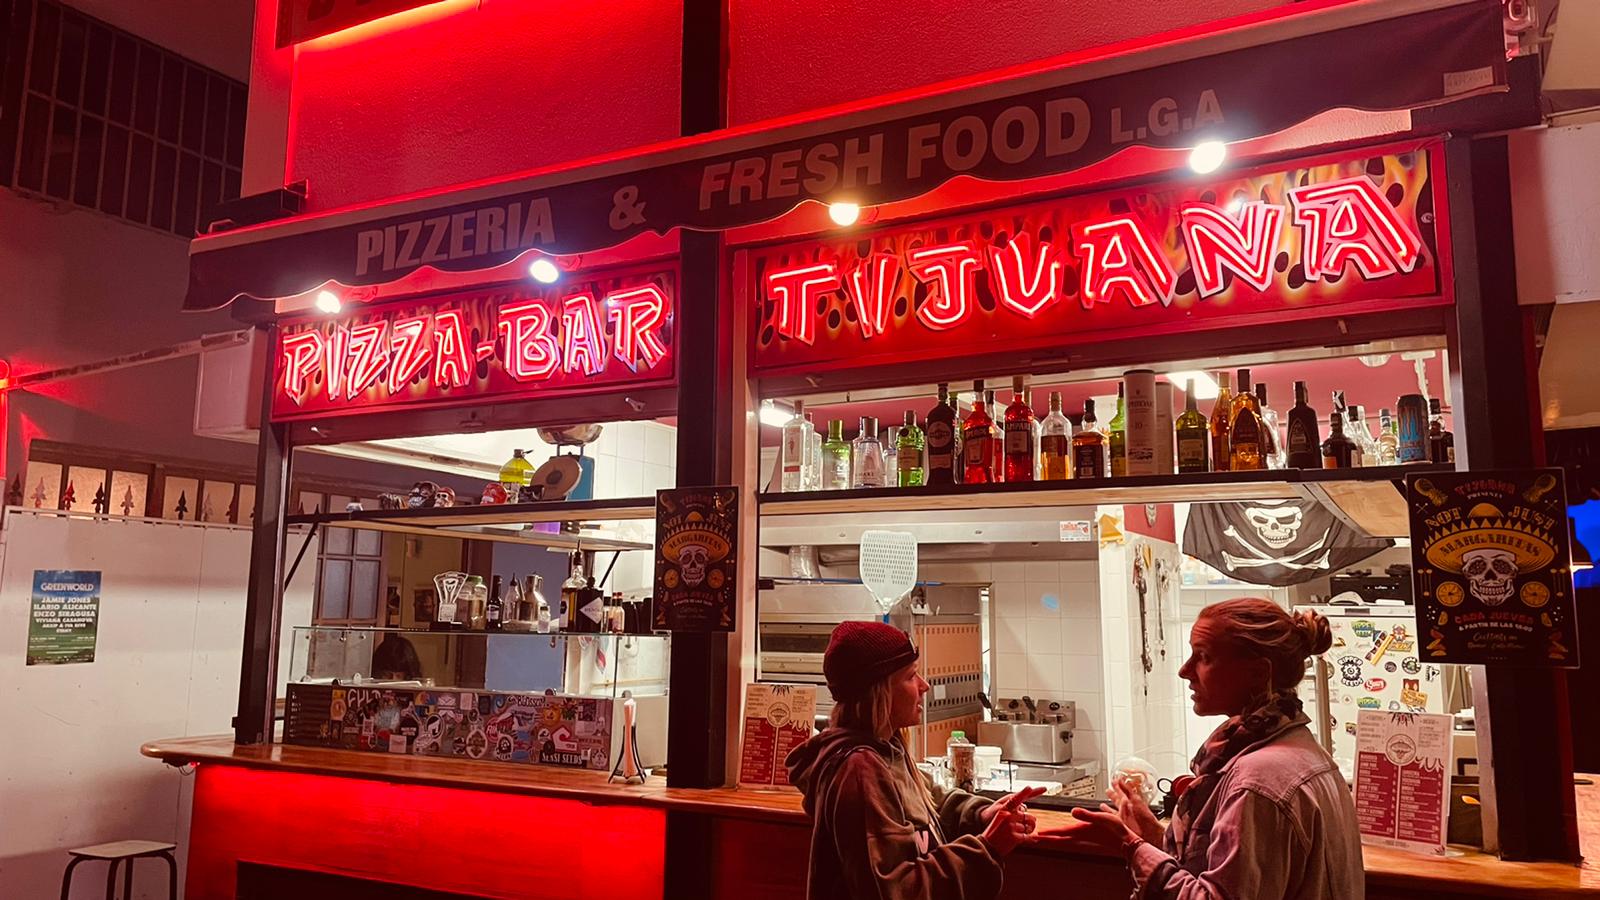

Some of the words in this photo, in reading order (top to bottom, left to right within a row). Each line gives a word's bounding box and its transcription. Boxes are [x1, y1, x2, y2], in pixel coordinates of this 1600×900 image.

[355, 197, 556, 276] PIZZERIA
[608, 184, 647, 230] &
[700, 130, 886, 211] FRESH
[906, 97, 1092, 179] FOOD
[766, 174, 1422, 346] TIJUANA
[282, 282, 671, 407] PIZZA-BAR
[1439, 533, 1541, 557] MARGARITAS
[41, 583, 94, 591] GREENWORLD
[562, 753, 583, 765] SEEDS
